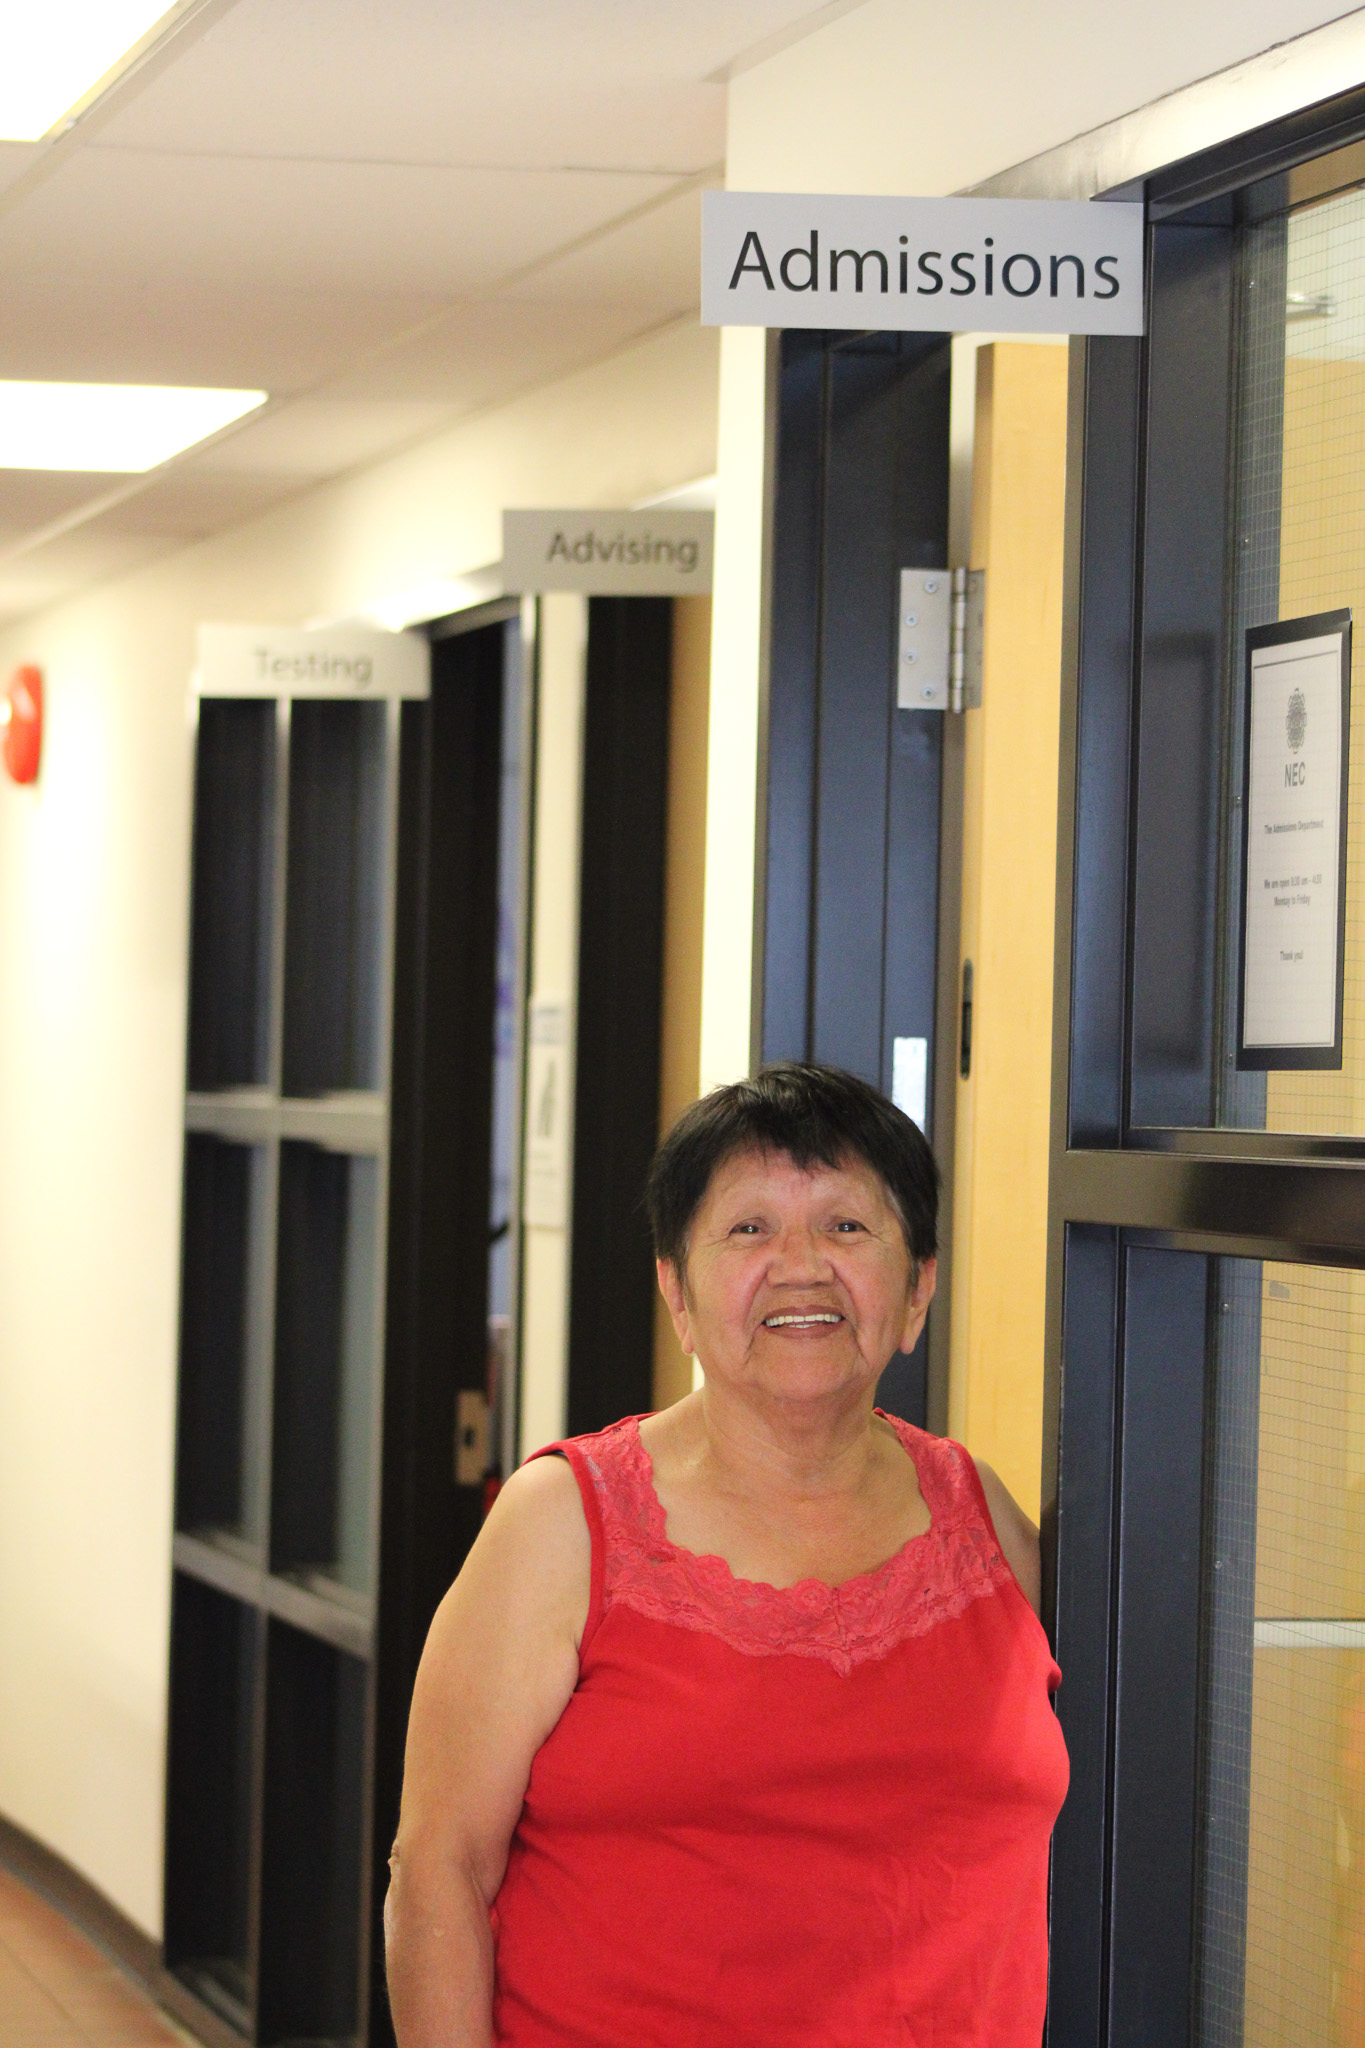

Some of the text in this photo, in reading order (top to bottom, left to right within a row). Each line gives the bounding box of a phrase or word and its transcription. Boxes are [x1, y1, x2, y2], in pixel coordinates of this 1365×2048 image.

[728, 229, 1120, 300] Admissions
[545, 530, 699, 573] Advising
[254, 648, 373, 683] Testing
[1284, 762, 1306, 787] NEC
